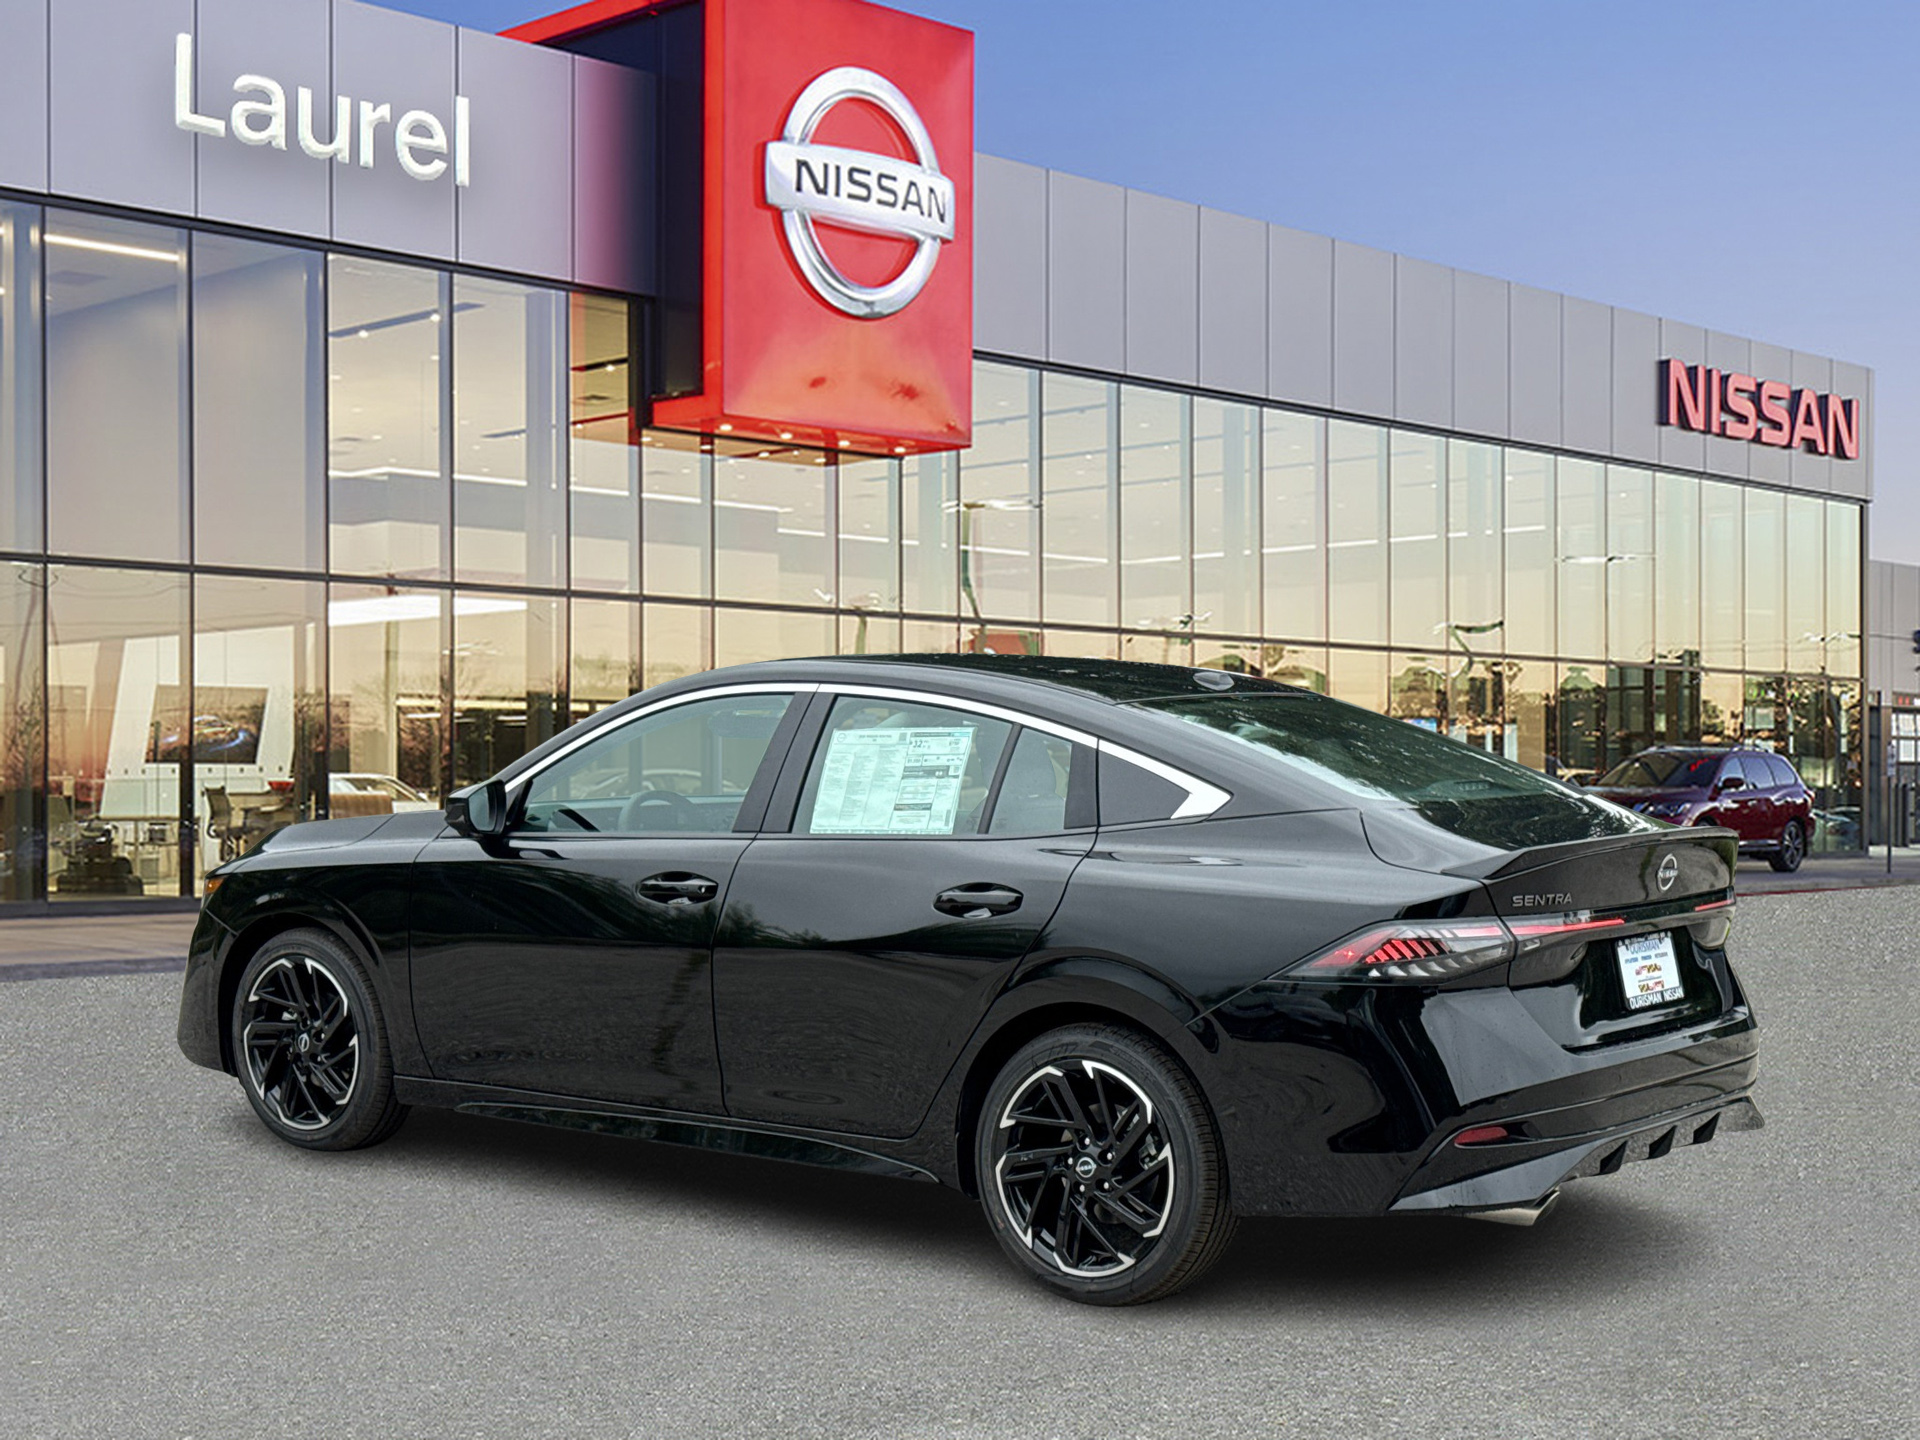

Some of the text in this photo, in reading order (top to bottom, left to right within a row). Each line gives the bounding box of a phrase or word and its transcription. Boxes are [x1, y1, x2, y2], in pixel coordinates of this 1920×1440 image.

[175, 33, 470, 188] Laurel
[795, 158, 946, 224] NISSAN
[1659, 358, 1860, 460] NISSAN
[1512, 893, 1573, 908] SENTRA
[1630, 987, 1685, 1009] OURISMAN NISSAN
